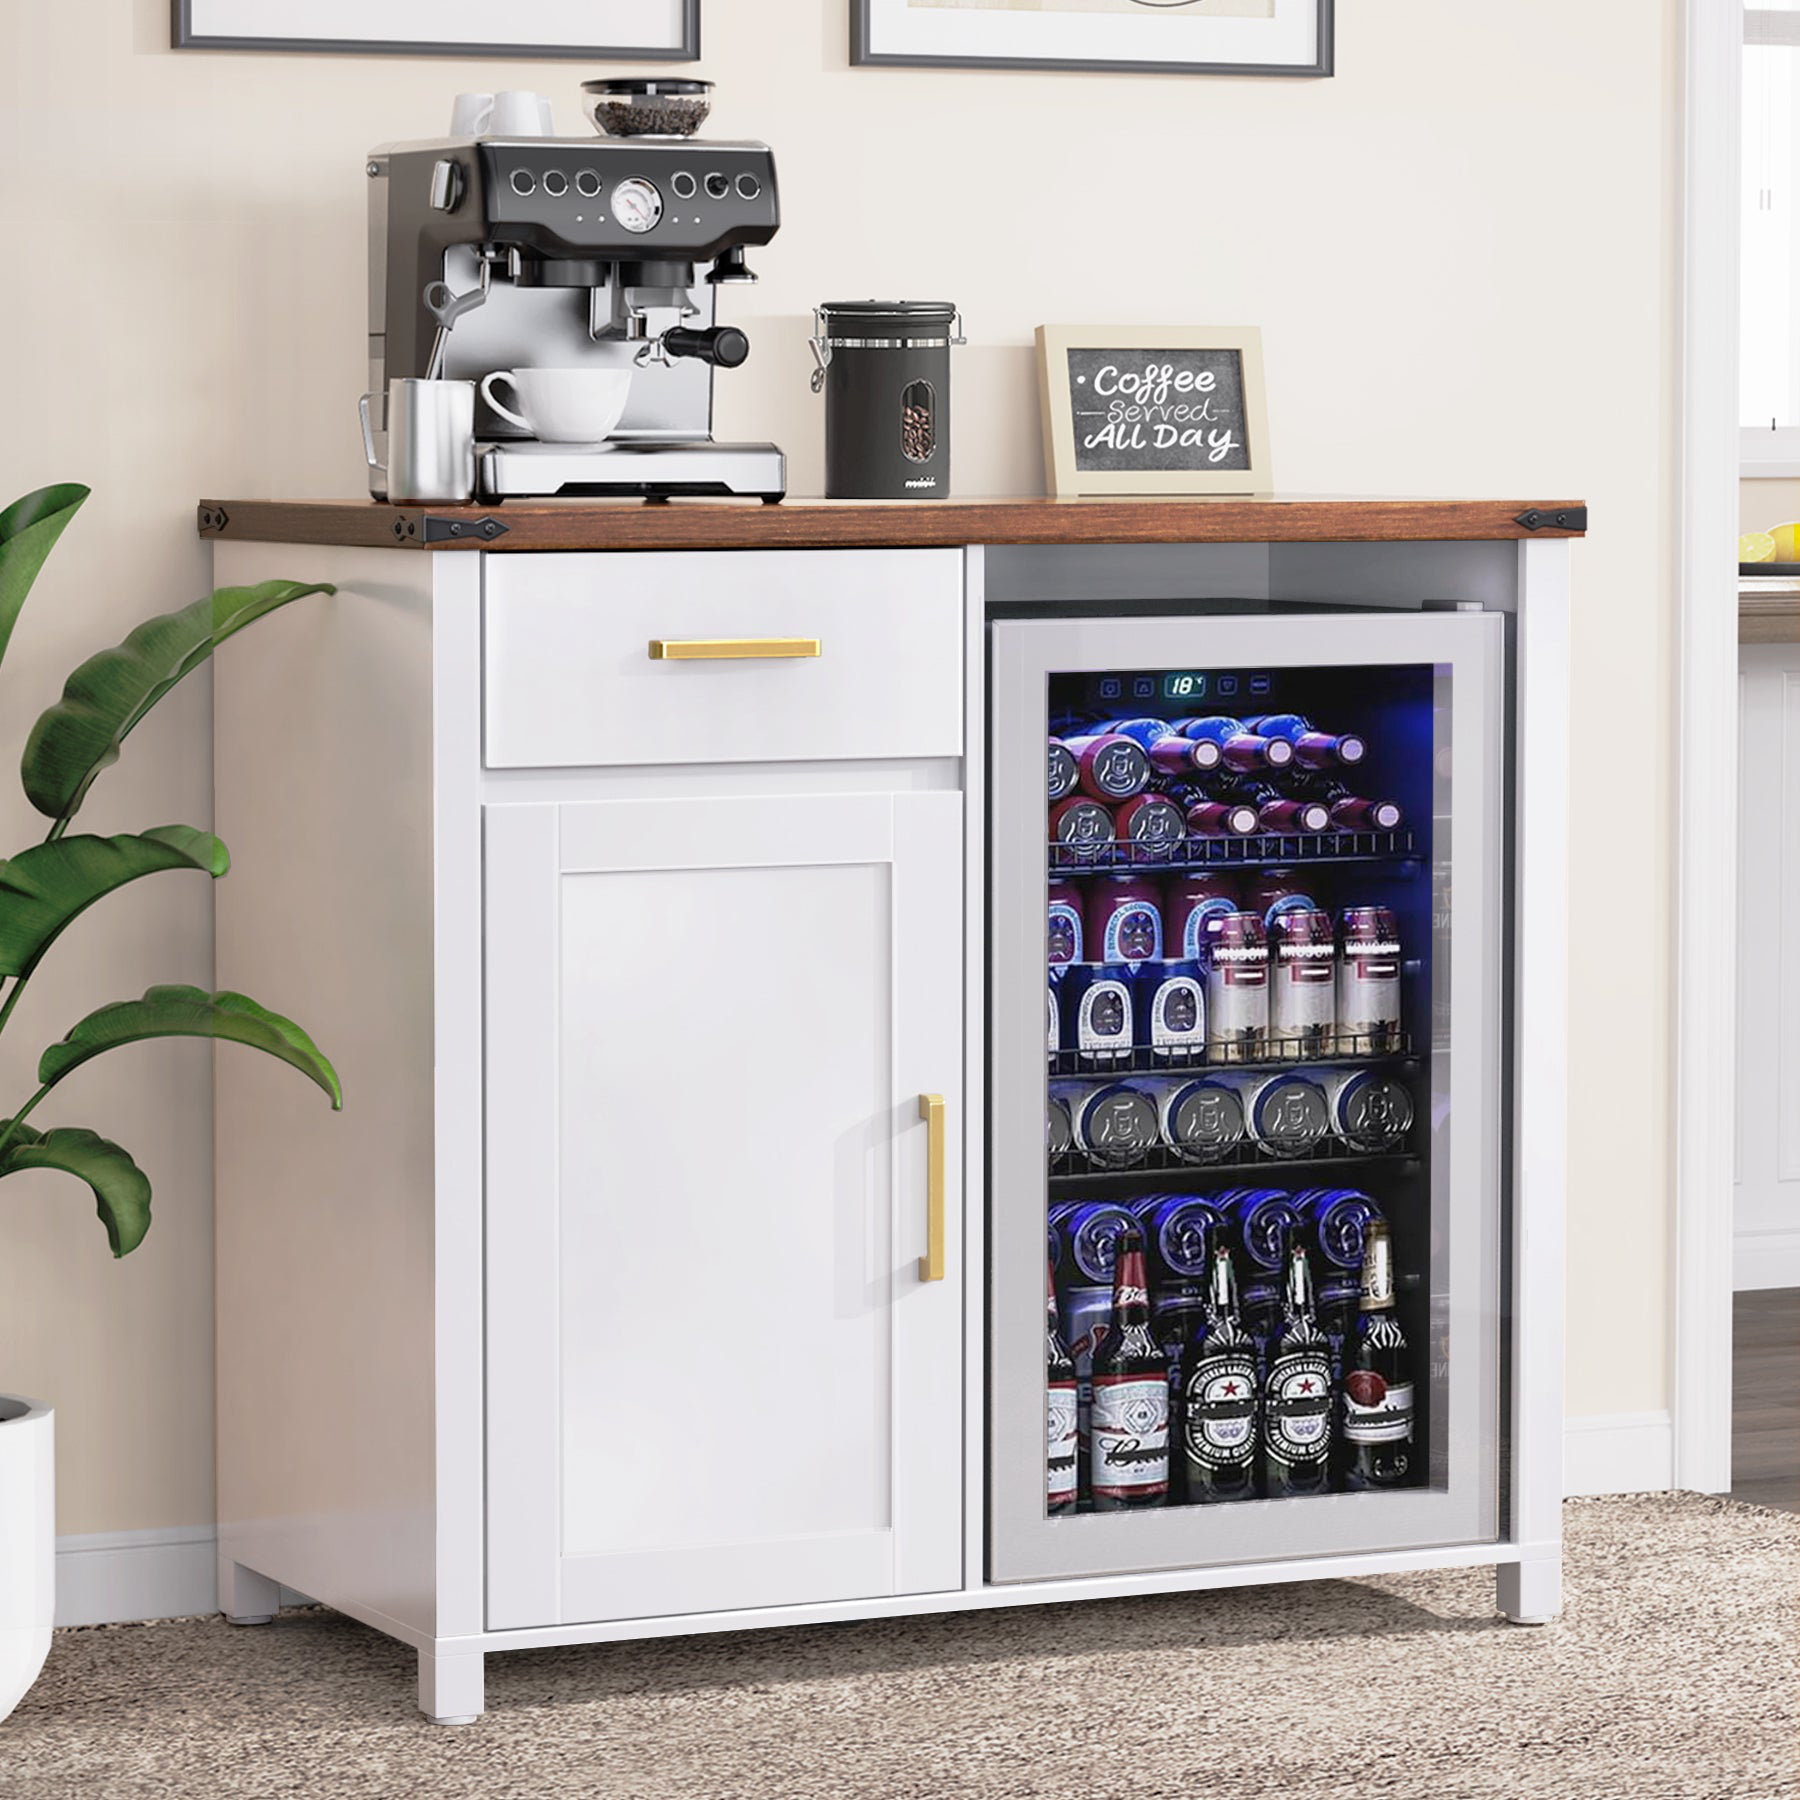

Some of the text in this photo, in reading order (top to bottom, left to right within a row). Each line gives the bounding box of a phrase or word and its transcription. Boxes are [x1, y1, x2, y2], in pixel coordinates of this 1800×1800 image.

[1094, 364, 1216, 405] Coffee
[1107, 398, 1218, 423] Served
[1084, 423, 1240, 462] All Day
